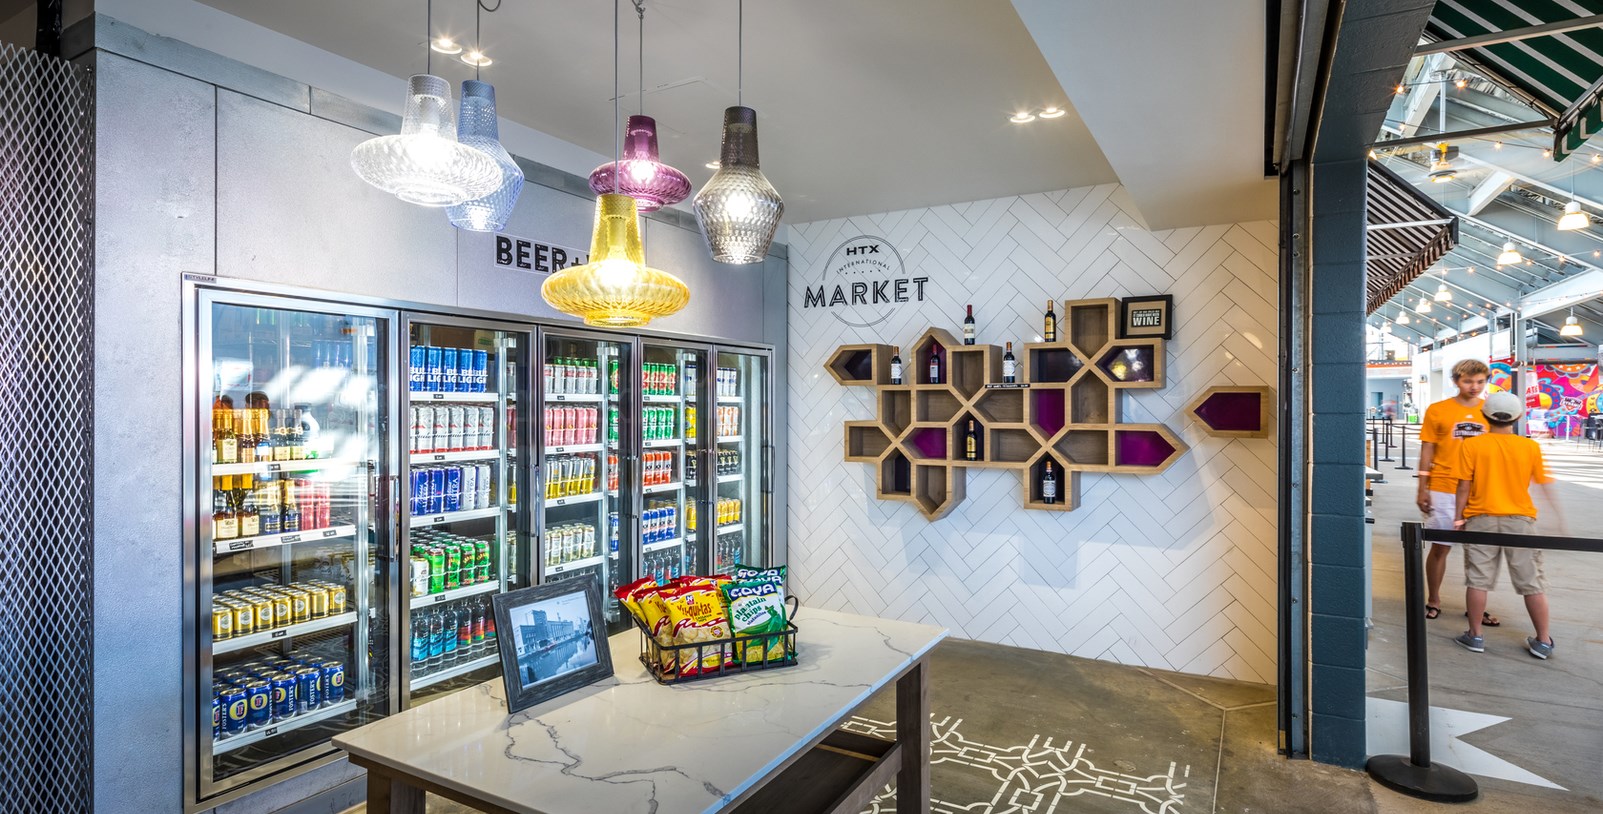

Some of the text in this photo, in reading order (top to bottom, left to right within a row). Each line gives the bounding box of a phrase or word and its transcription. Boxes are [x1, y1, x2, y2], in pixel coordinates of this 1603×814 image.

[846, 244, 880, 256] HTX
[836, 258, 890, 275] INTERNATIONAL
[803, 277, 929, 309] MARKET
[1133, 316, 1160, 326] WINE
[730, 583, 775, 598] GOYA
[742, 605, 762, 622] chips
